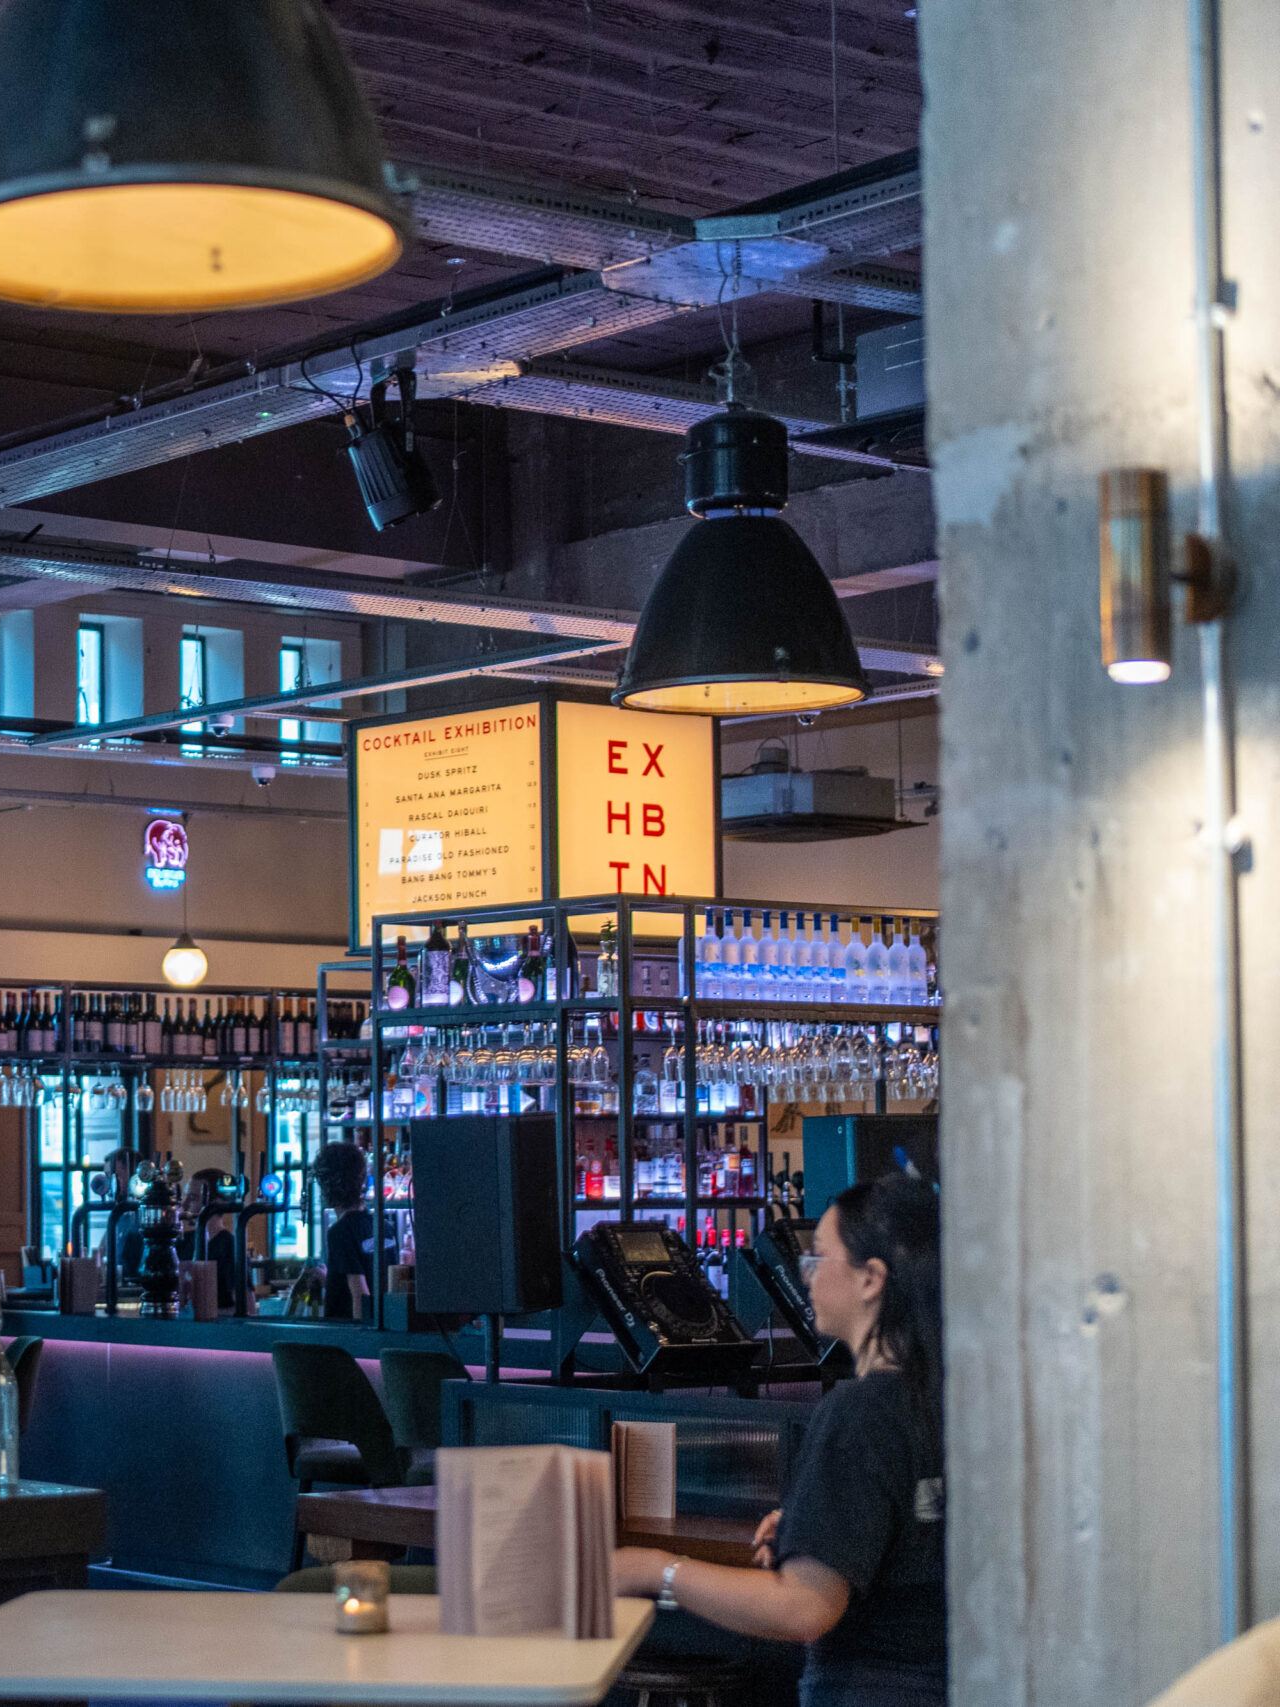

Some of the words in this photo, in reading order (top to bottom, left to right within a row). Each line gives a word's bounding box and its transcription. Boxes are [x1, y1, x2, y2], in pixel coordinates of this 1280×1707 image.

[363, 730, 436, 751] COCKTAIL
[444, 714, 536, 740] EXHIBITION
[418, 771, 441, 780] DUSK
[445, 765, 477, 777] SPRITZ
[396, 793, 423, 803] SANTA
[428, 791, 445, 799] ANA
[450, 784, 501, 796] MARGARITA
[409, 811, 443, 821] RASCAL
[448, 806, 488, 818] DAIQUIRI
[455, 827, 487, 837] HIBALL
[438, 850, 454, 860] OLD
[458, 845, 509, 857] FASHIONED
[401, 874, 425, 884] BANG
[429, 871, 452, 882] BANG
[457, 867, 497, 878] TOMMY'S
[412, 892, 452, 903] JACKSON
[456, 889, 487, 899] PUNCH
